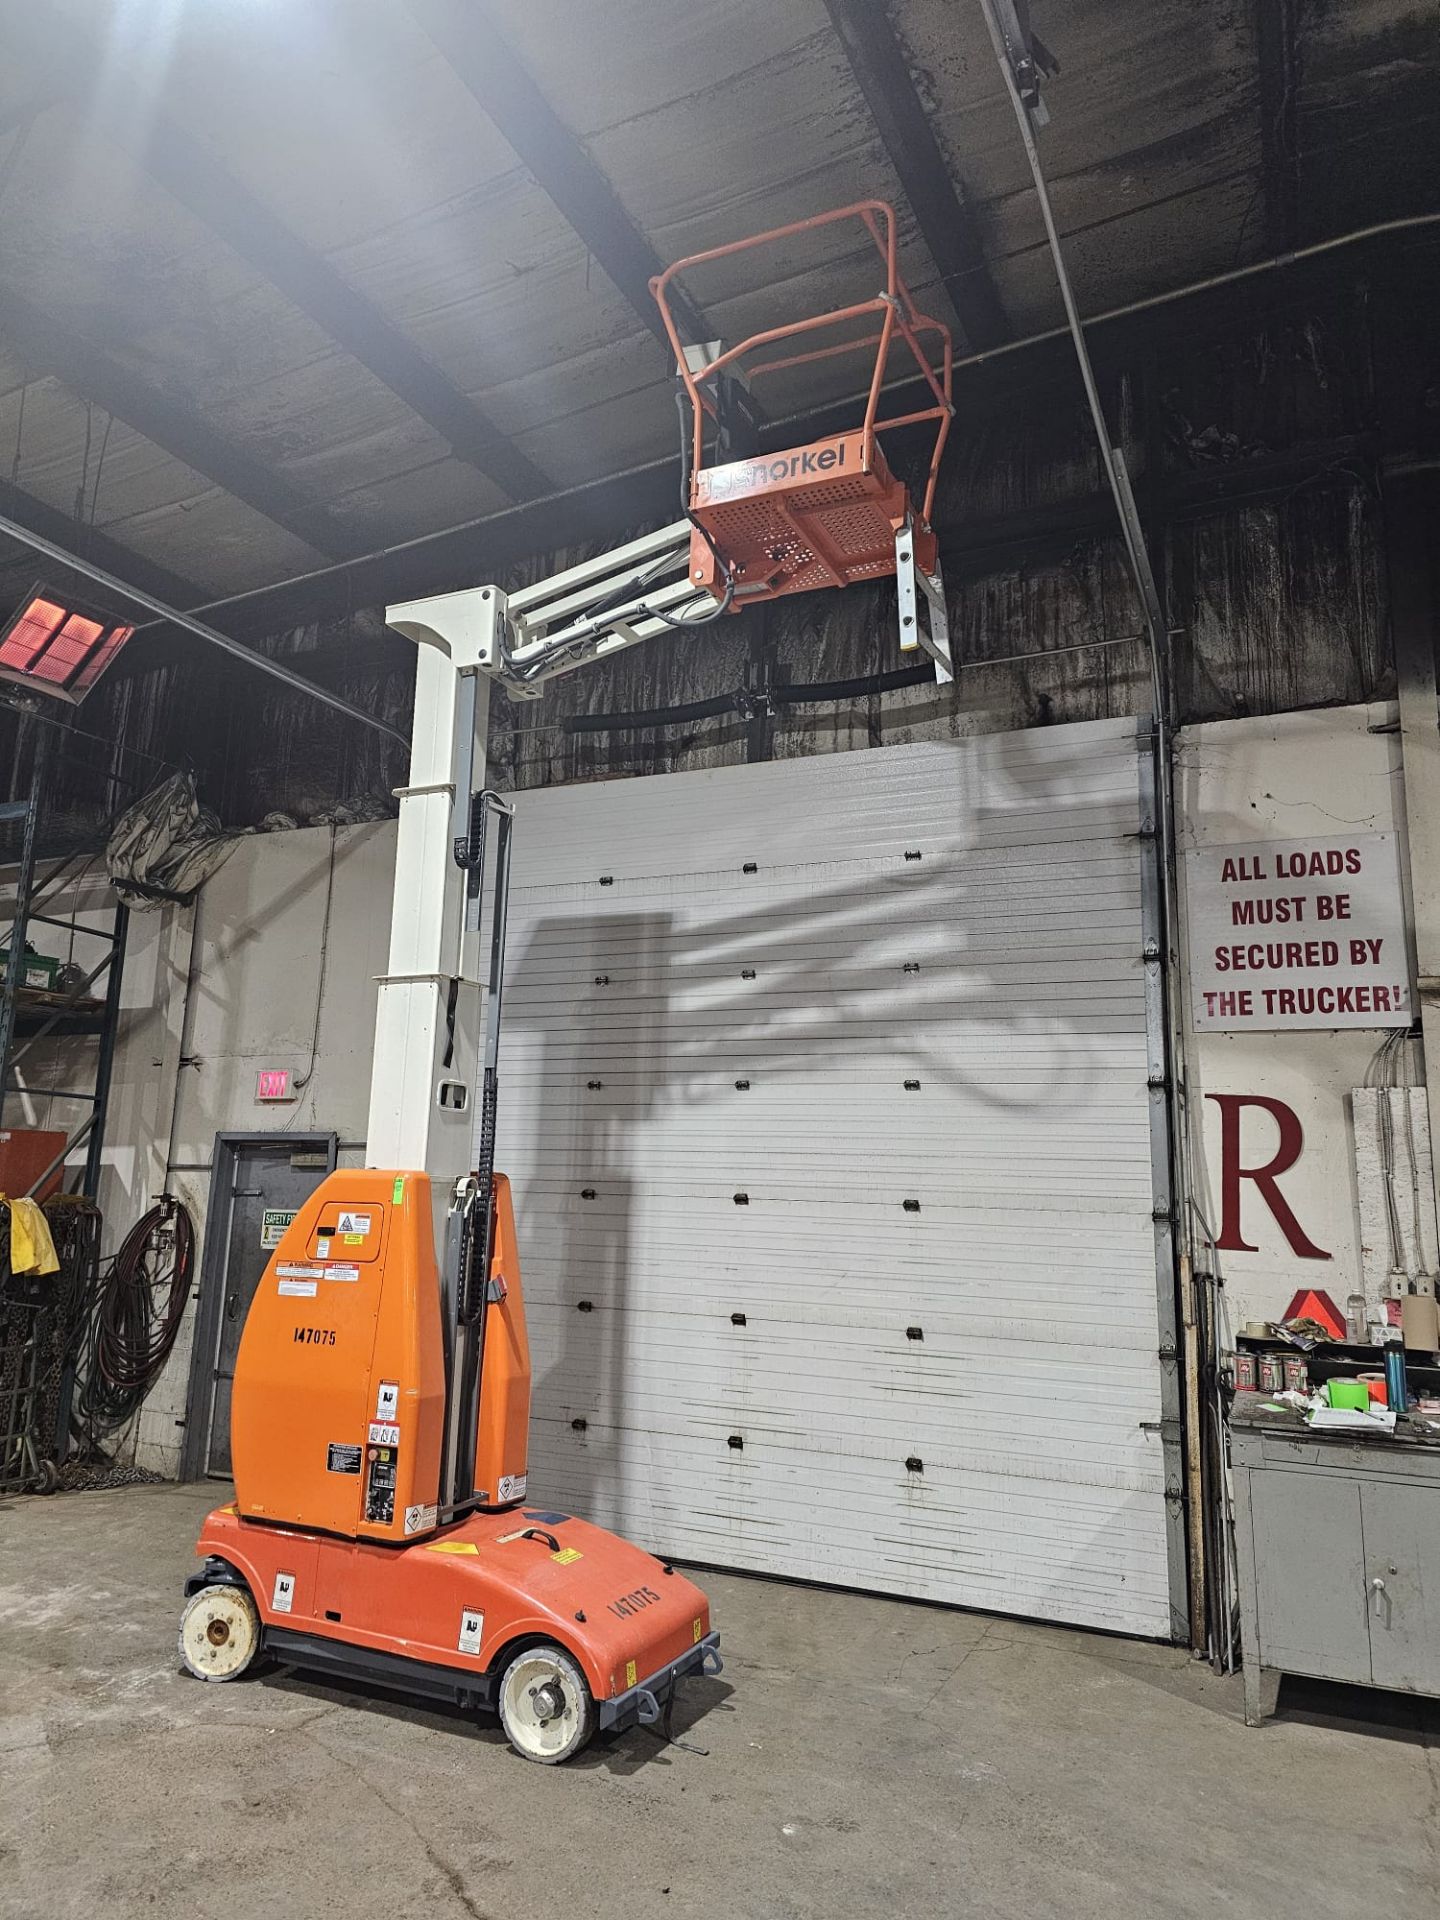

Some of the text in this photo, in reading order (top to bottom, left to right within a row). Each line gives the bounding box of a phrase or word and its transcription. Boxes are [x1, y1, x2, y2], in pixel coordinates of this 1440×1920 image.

[1221, 849, 1361, 882] ALL LOADS
[1231, 894, 1351, 925] MUST BE
[1215, 939, 1384, 971] SECURED BY
[1203, 985, 1402, 1017] THE TRUCKER!
[259, 1071, 288, 1096] EXIT
[1205, 1093, 1332, 1260] R
[265, 1213, 287, 1225] SAFETY
[293, 1327, 336, 1346] 147075
[606, 1586, 661, 1620] 147075
